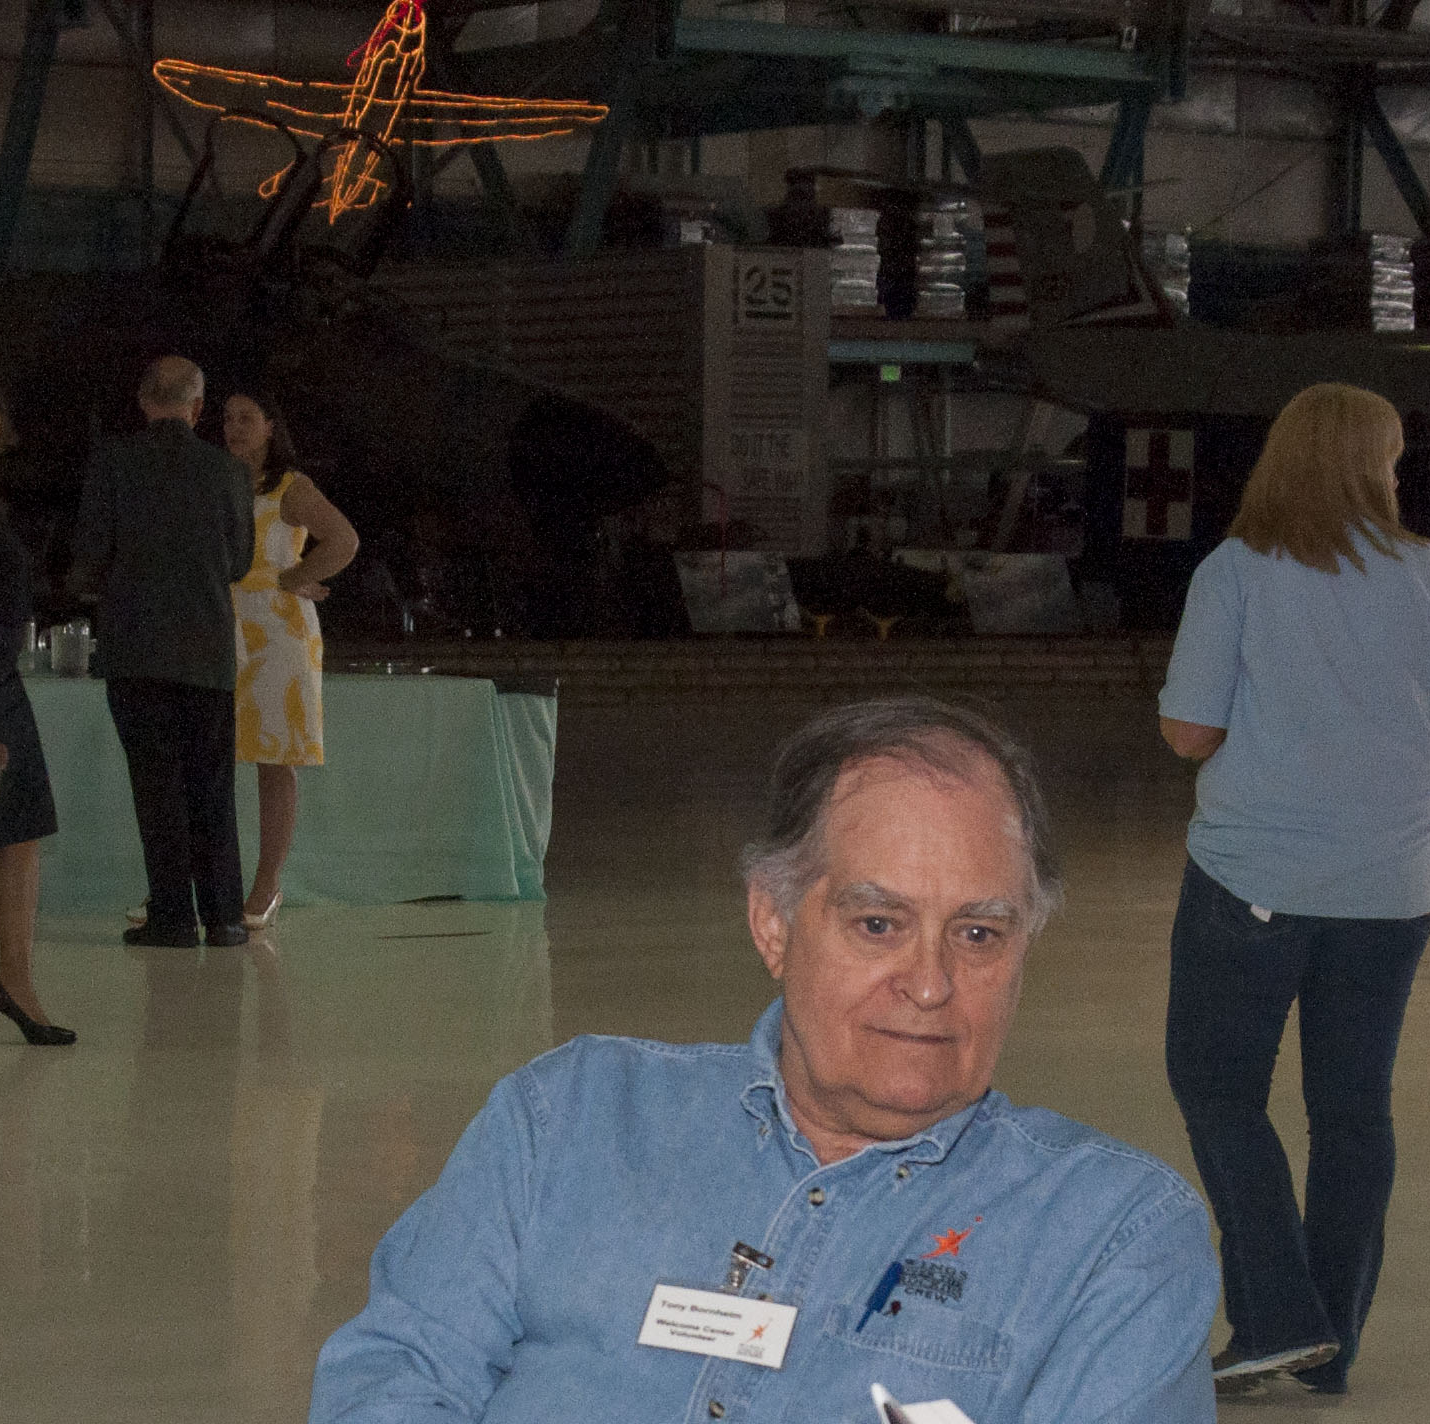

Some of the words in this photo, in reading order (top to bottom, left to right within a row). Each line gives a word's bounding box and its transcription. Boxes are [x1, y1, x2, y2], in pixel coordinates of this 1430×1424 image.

[744, 265, 793, 307] 25
[655, 1318, 700, 1331] Welcome
[703, 1325, 735, 1337] Center
[669, 1329, 717, 1342] Volunteer
